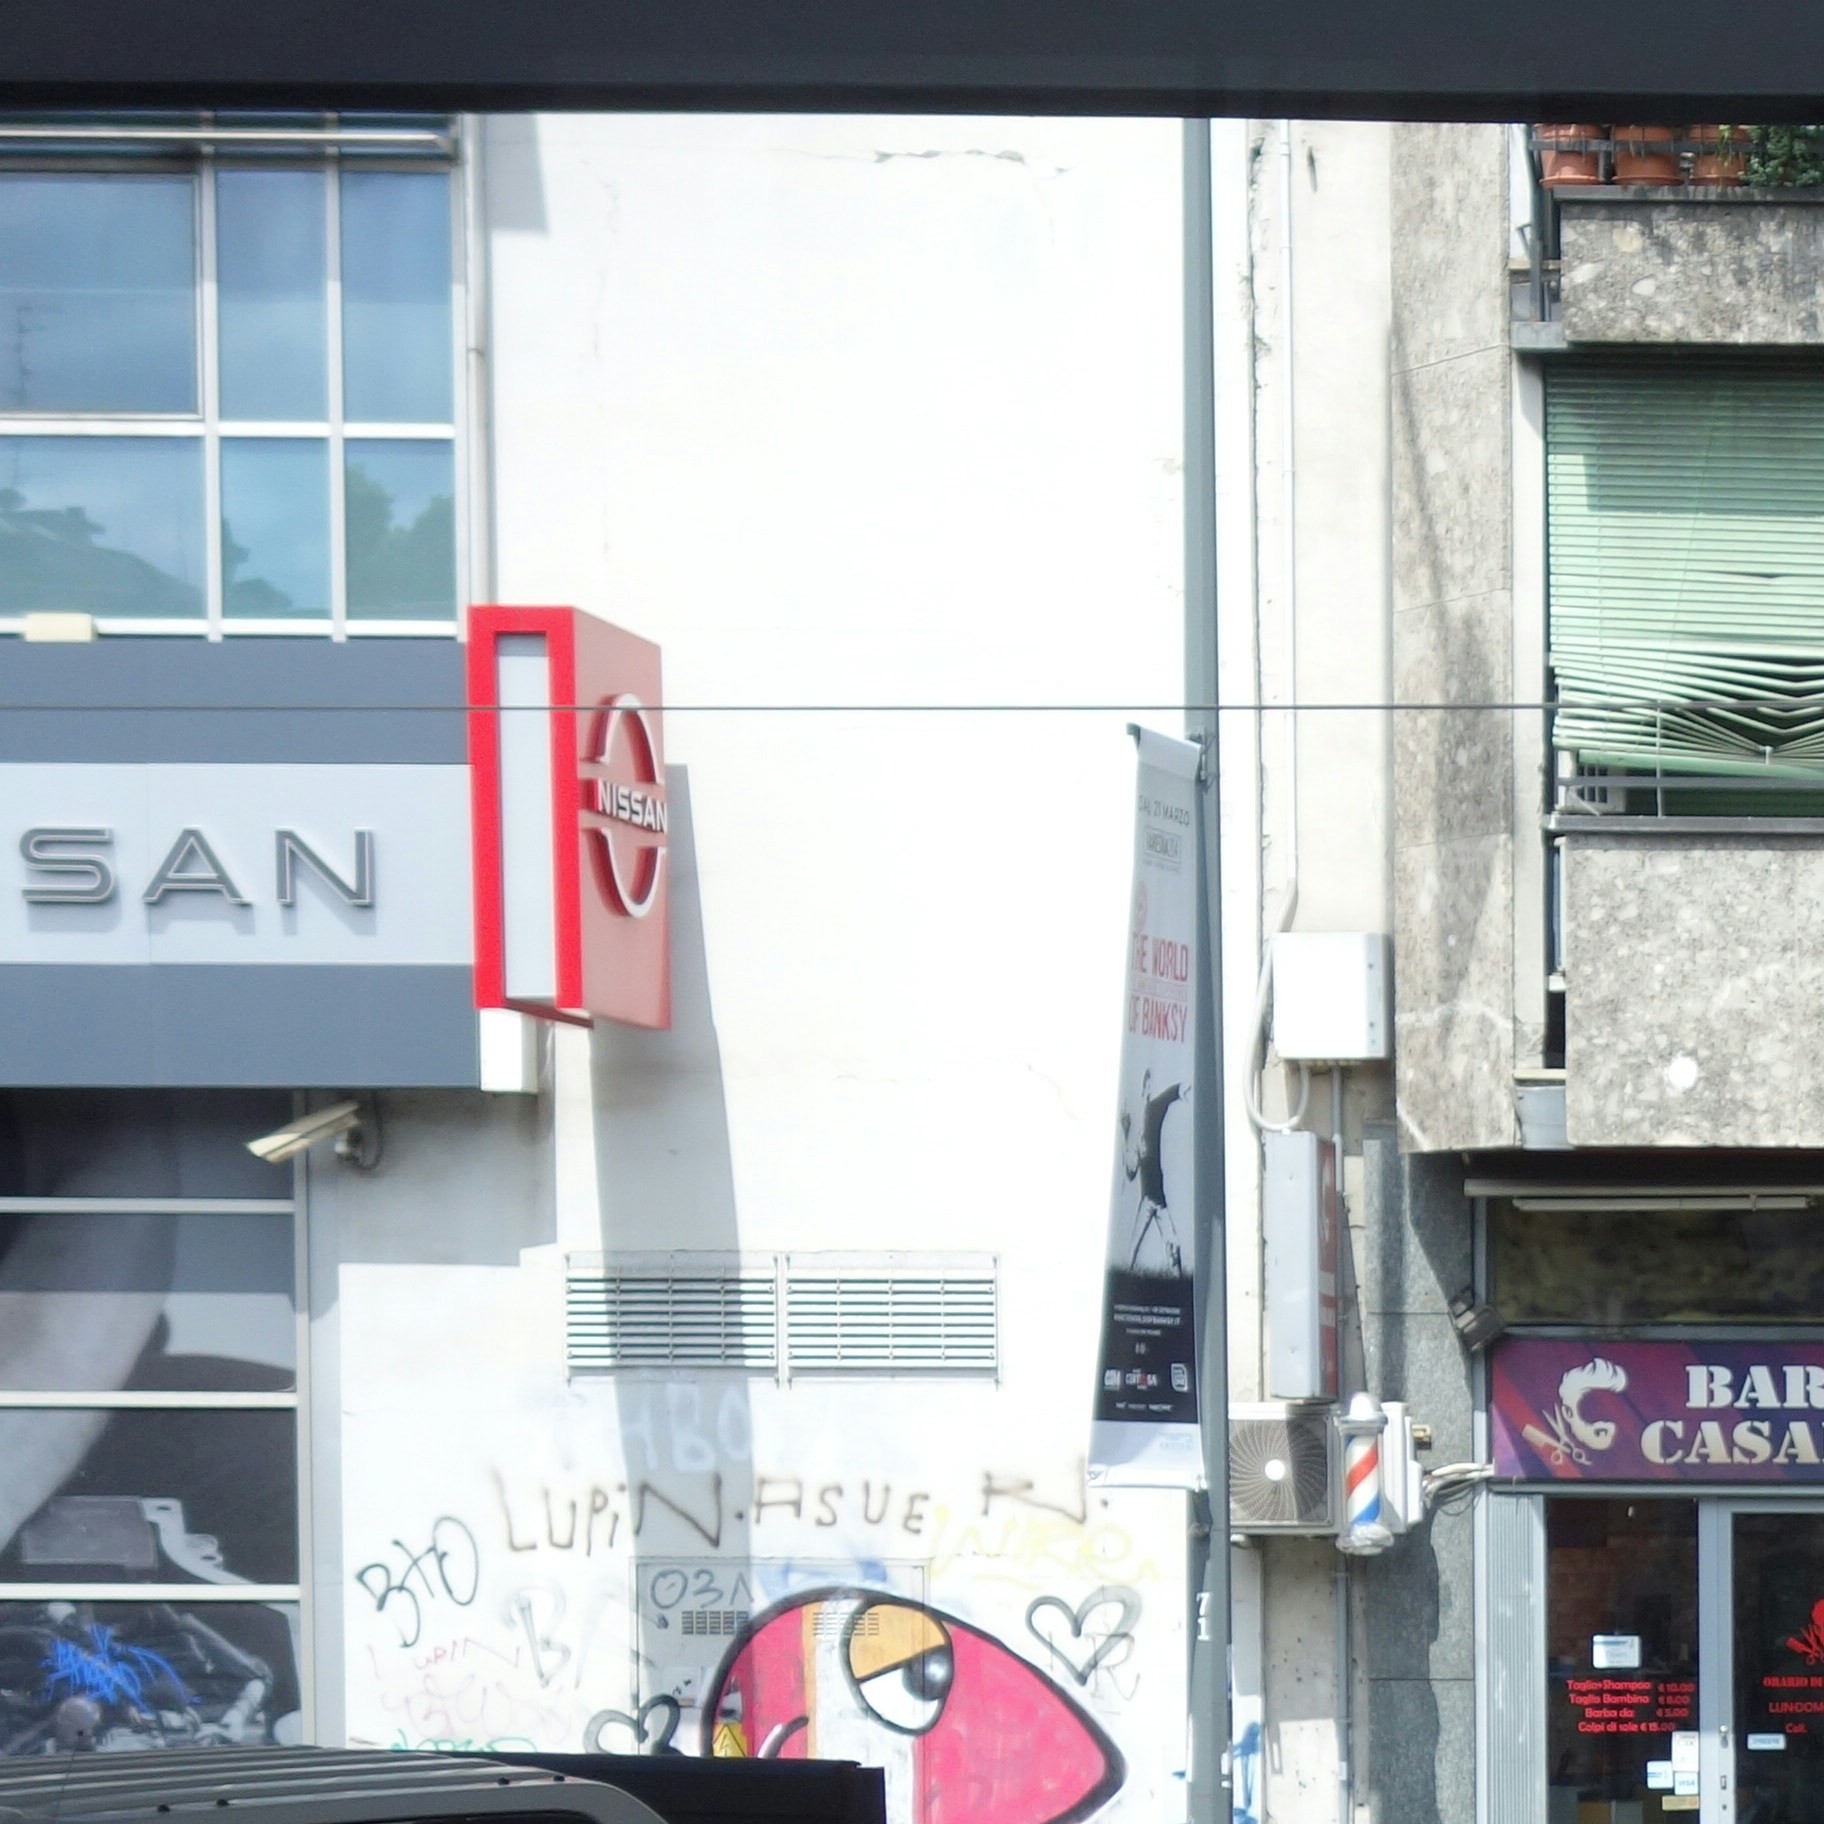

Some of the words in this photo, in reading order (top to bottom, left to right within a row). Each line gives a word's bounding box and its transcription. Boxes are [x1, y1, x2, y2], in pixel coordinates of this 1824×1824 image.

[597, 777, 668, 833] NISSAN
[1162, 805, 1190, 826] MARZO
[18, 827, 376, 908] SAN
[1151, 935, 1189, 982] WORLD
[1141, 998, 1188, 1043] BANKSY
[1763, 1676, 1808, 1688] ORARIO
[1810, 1676, 1822, 1688] DI
[1569, 1693, 1602, 1705] Taglio
[1603, 1693, 1650, 1704] Bambino
[1585, 1707, 1617, 1718] Barba
[1619, 1708, 1634, 1718] da
[1578, 1721, 1605, 1733] Colpi
[1619, 1723, 1638, 1732] sole
